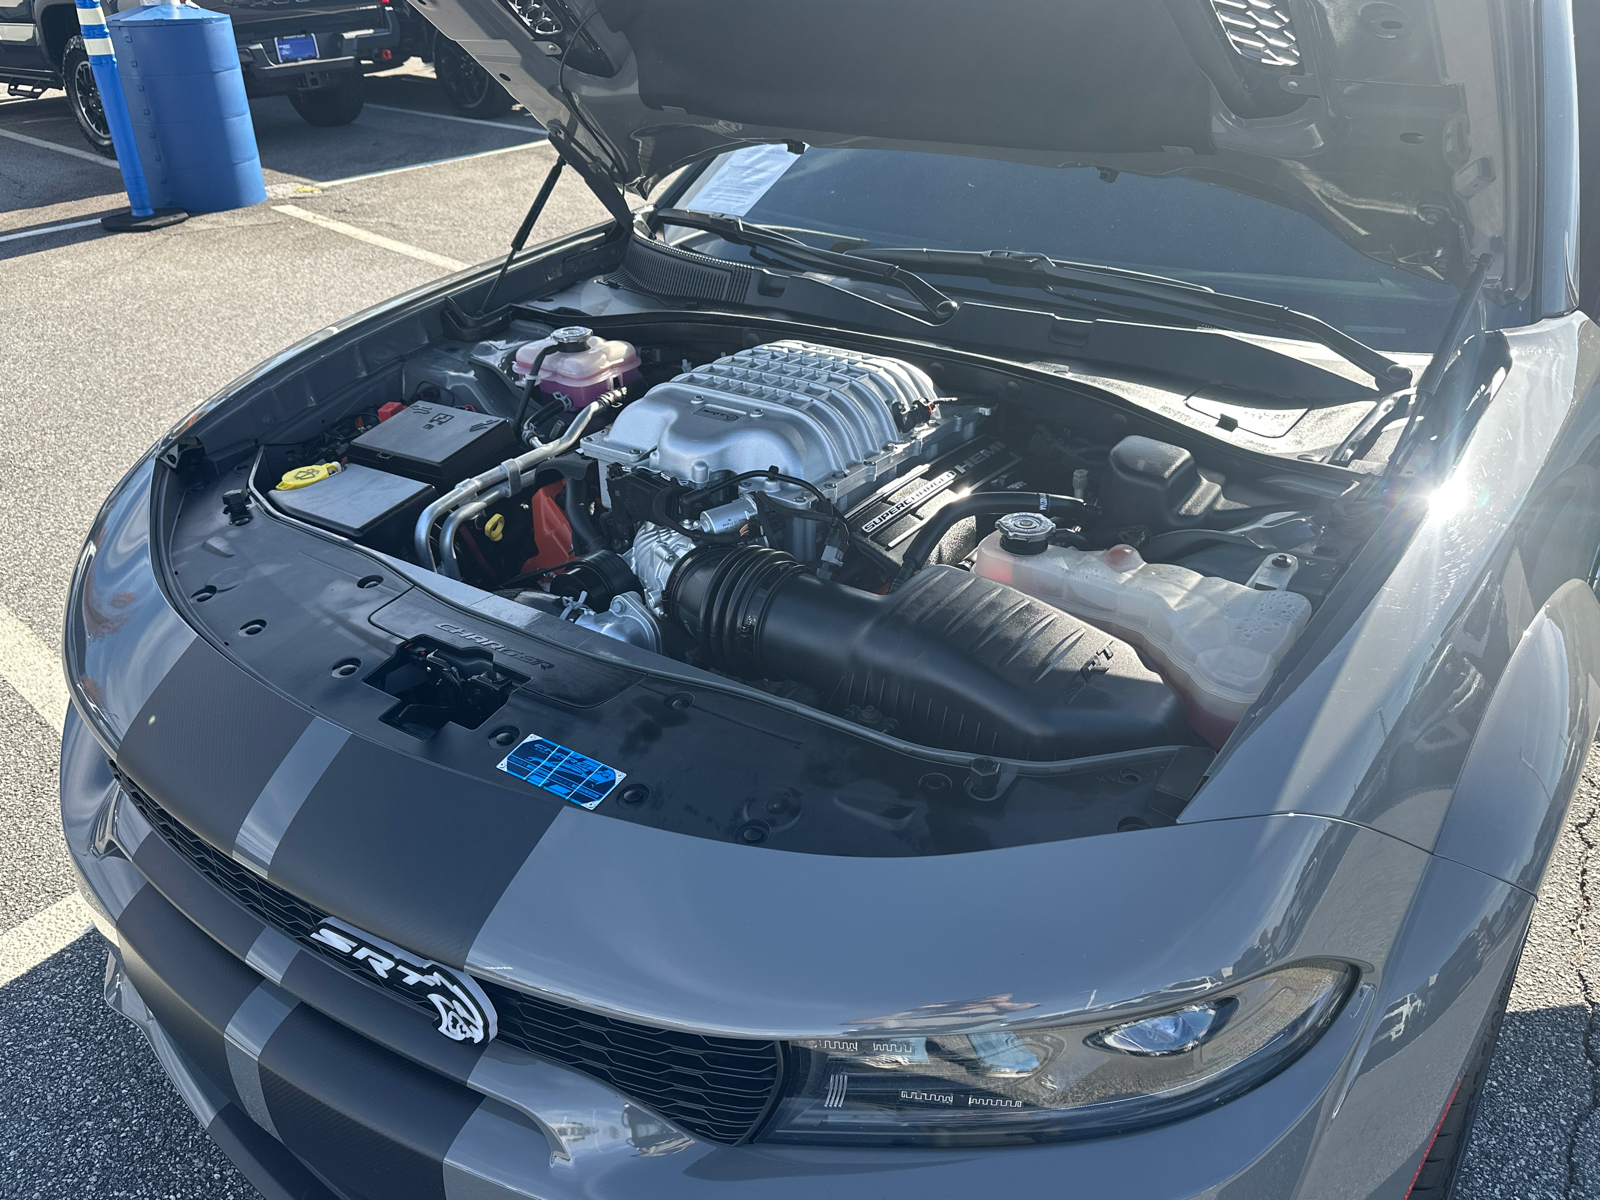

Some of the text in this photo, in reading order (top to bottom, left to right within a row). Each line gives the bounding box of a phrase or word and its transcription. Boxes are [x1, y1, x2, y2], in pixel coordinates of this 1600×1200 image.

[954, 440, 1007, 474] HEMI
[863, 470, 957, 532] SUPERCHARGED
[435, 623, 555, 670] CHARGER
[1061, 640, 1114, 706] SRT
[310, 928, 436, 987] SRT
